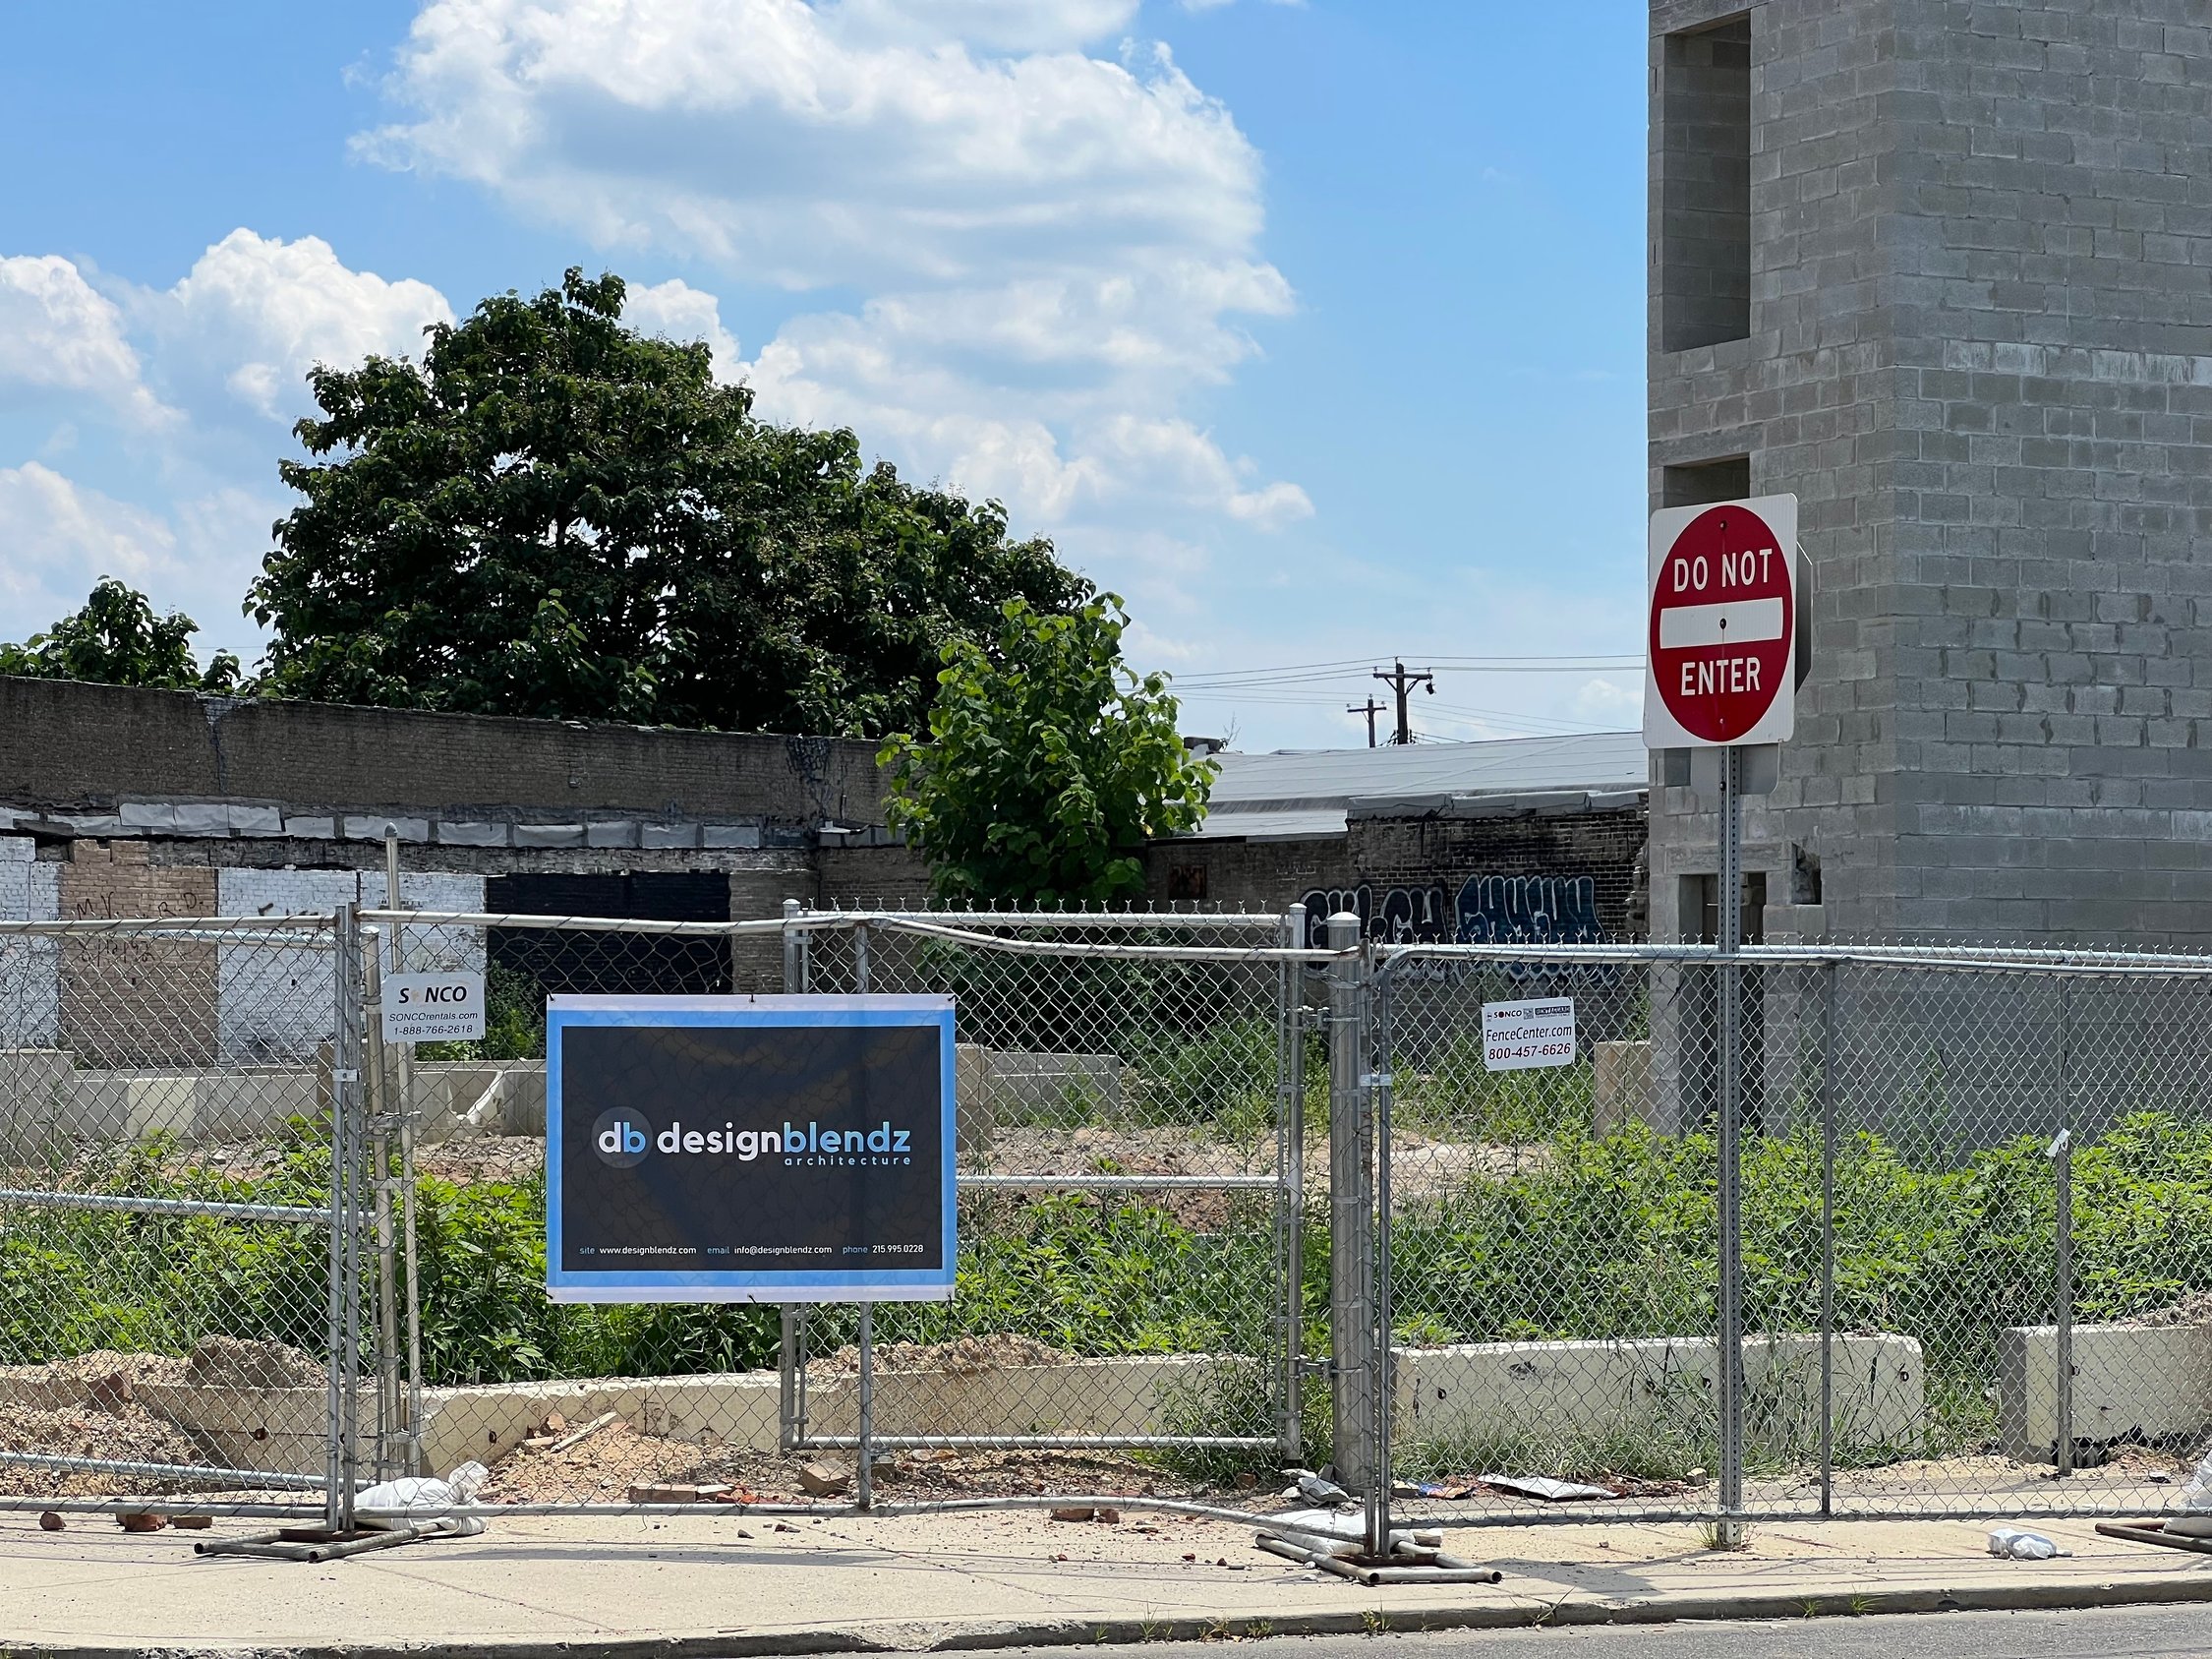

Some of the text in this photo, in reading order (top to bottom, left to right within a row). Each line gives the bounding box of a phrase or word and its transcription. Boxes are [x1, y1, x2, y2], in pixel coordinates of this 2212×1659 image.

[1673, 548, 1773, 592] DO NOT
[1680, 657, 1761, 696] ENTER
[398, 985, 467, 1004] SNCO
[388, 1012, 478, 1022] SONCOrentals.com
[394, 1025, 473, 1036] 1-888-766-2618
[1485, 1026, 1572, 1042] FenceCenter.com
[1488, 1042, 1571, 1060] 800-457-6626
[598, 1121, 911, 1161] db designblendz
[784, 1155, 911, 1165] architecture
[579, 1246, 596, 1255] site
[599, 1246, 697, 1256] www.designblendz.com
[707, 1246, 730, 1255] email
[734, 1246, 833, 1256] info@designblendz.com
[872, 1245, 924, 1254] 215.995.0228
